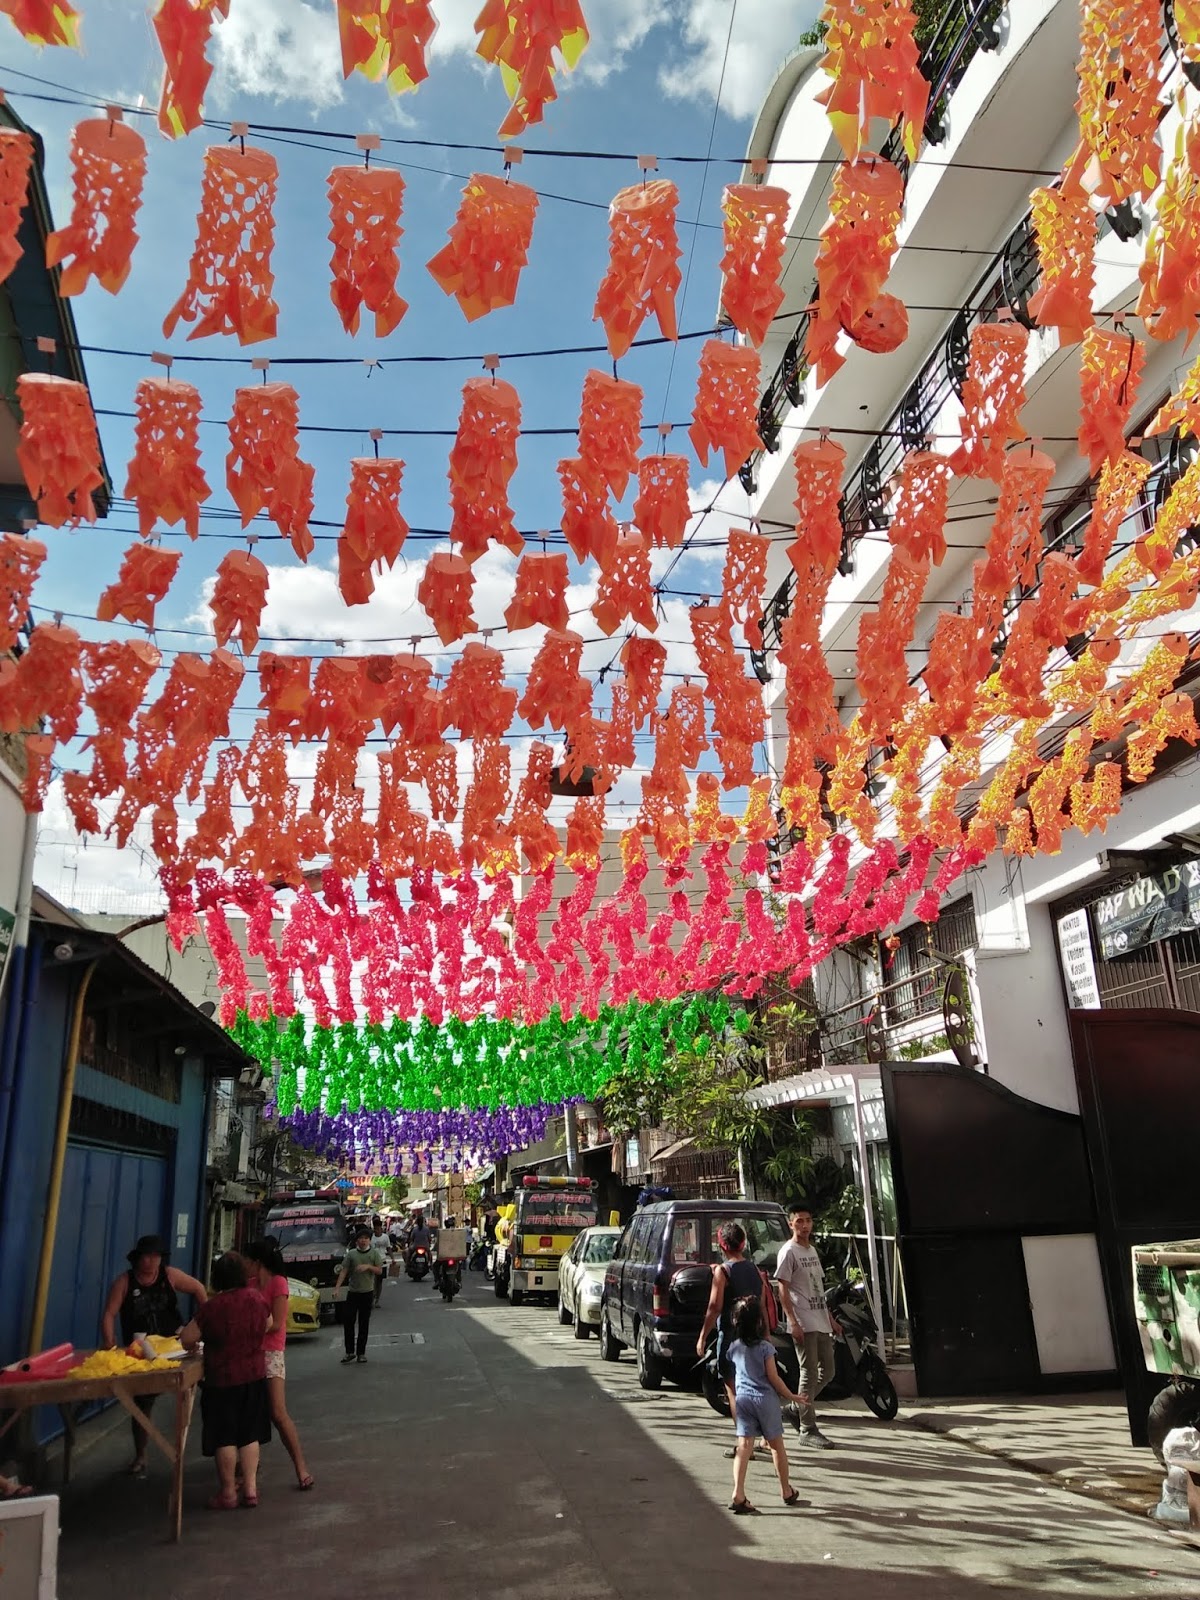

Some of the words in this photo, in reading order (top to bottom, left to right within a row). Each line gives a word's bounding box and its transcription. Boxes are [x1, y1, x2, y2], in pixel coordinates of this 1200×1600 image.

[1128, 868, 1181, 909] WAD
[525, 1215, 551, 1226] FIRE
[553, 1215, 596, 1226] RESCUE
